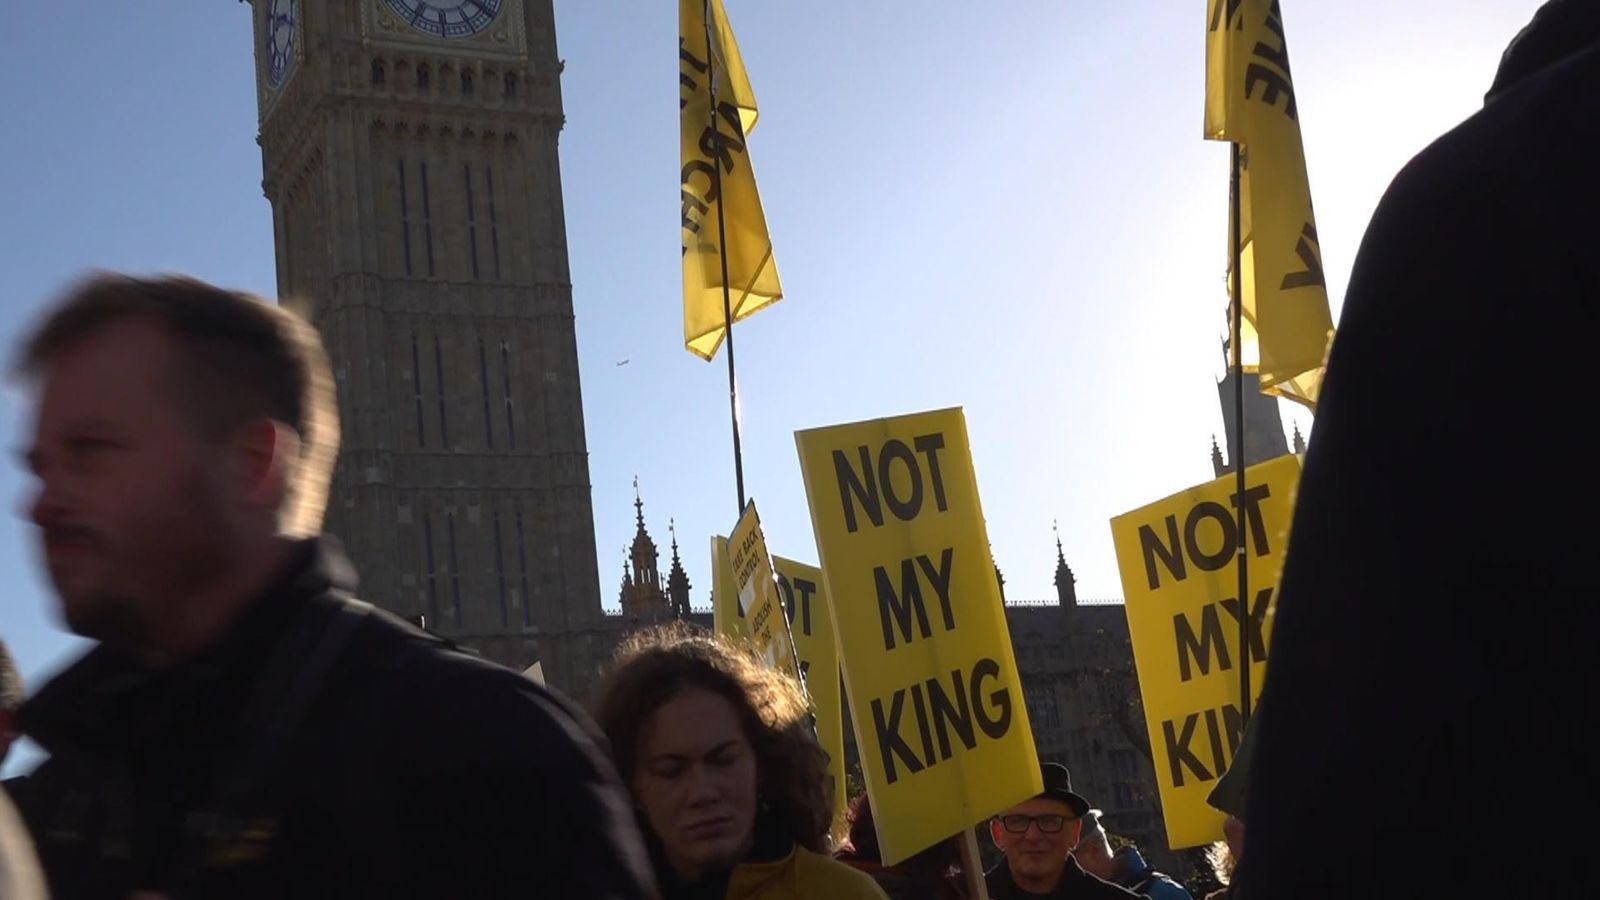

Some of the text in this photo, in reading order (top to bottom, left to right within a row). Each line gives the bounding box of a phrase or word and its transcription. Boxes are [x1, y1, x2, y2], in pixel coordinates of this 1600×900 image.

[832, 433, 948, 533] NOT
[738, 550, 760, 590] CONTROL
[742, 528, 759, 551] BACK
[1138, 483, 1271, 591] NOT
[752, 599, 773, 633] ABOLISH
[873, 547, 956, 651] MY
[1172, 587, 1274, 683] MY
[870, 657, 1012, 785] KING
